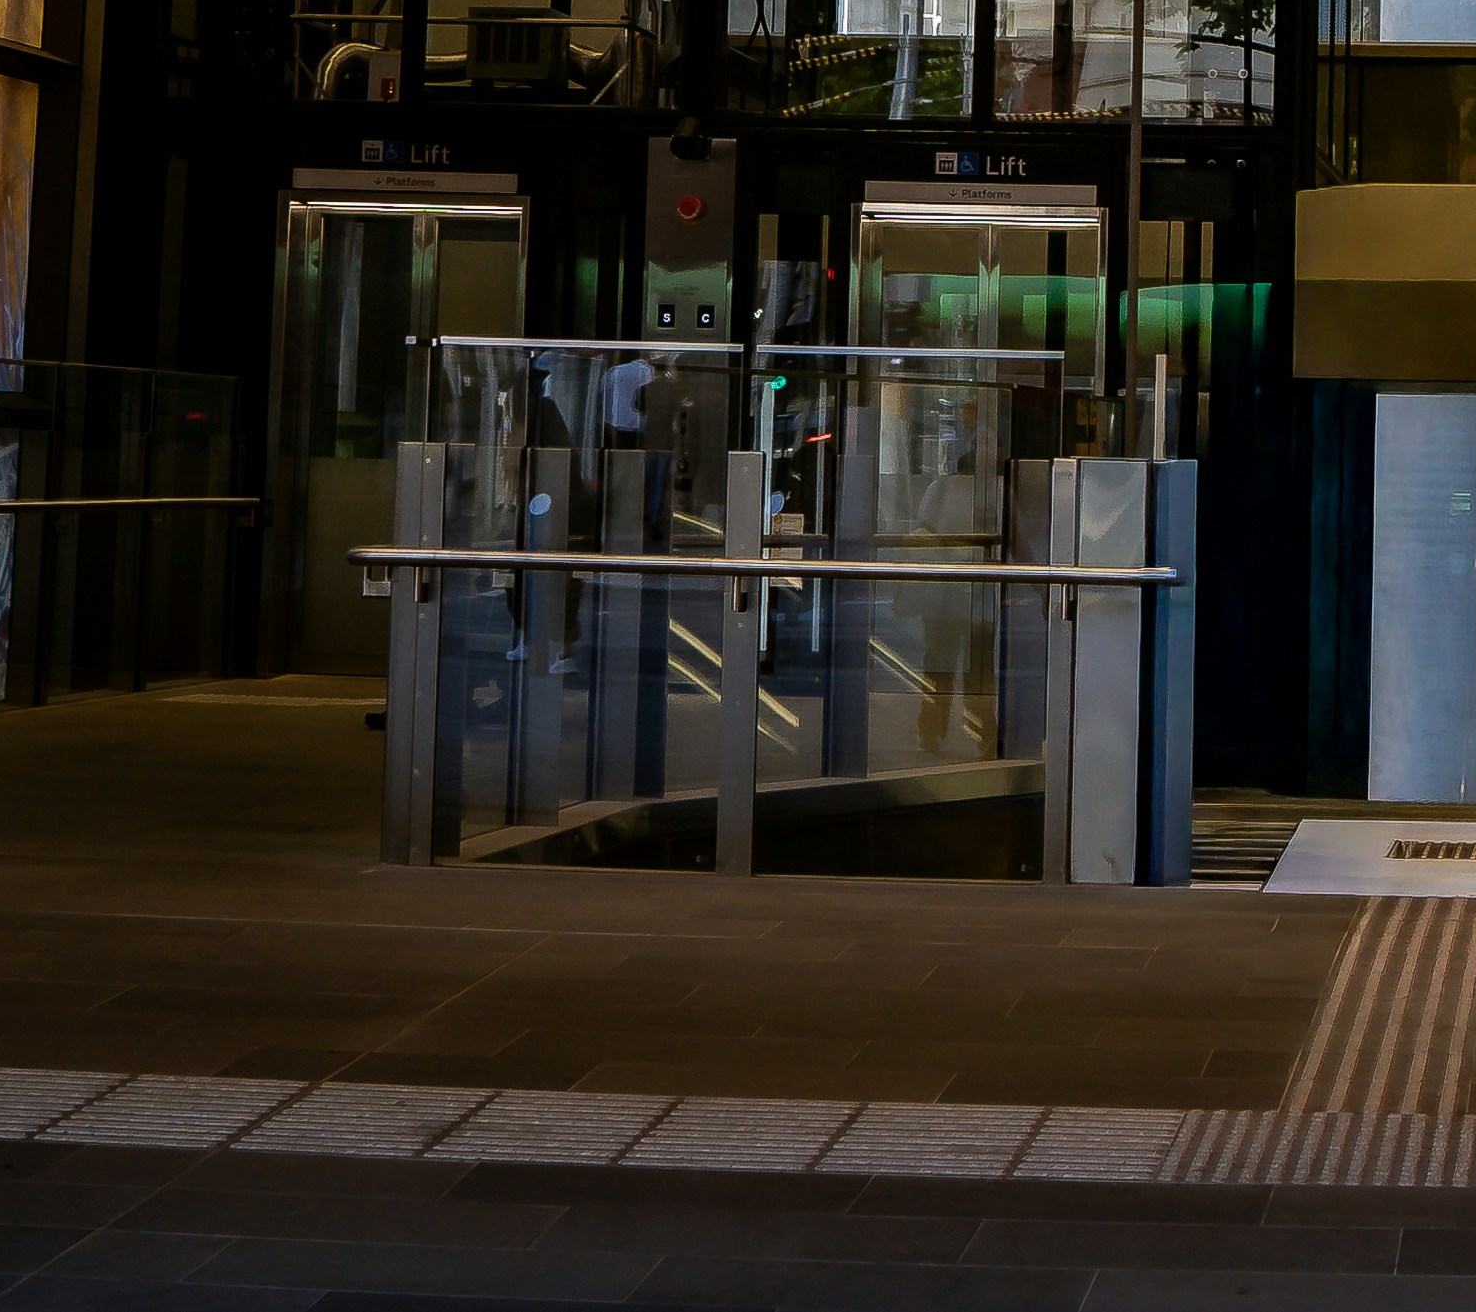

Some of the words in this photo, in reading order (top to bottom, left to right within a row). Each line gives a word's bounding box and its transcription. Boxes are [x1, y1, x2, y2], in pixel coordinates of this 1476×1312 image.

[410, 144, 451, 164] Lift
[985, 155, 1027, 176] Lift
[386, 176, 436, 188] Platforms
[961, 188, 1012, 200] Platforms
[662, 312, 671, 323] S
[701, 312, 710, 323] C
